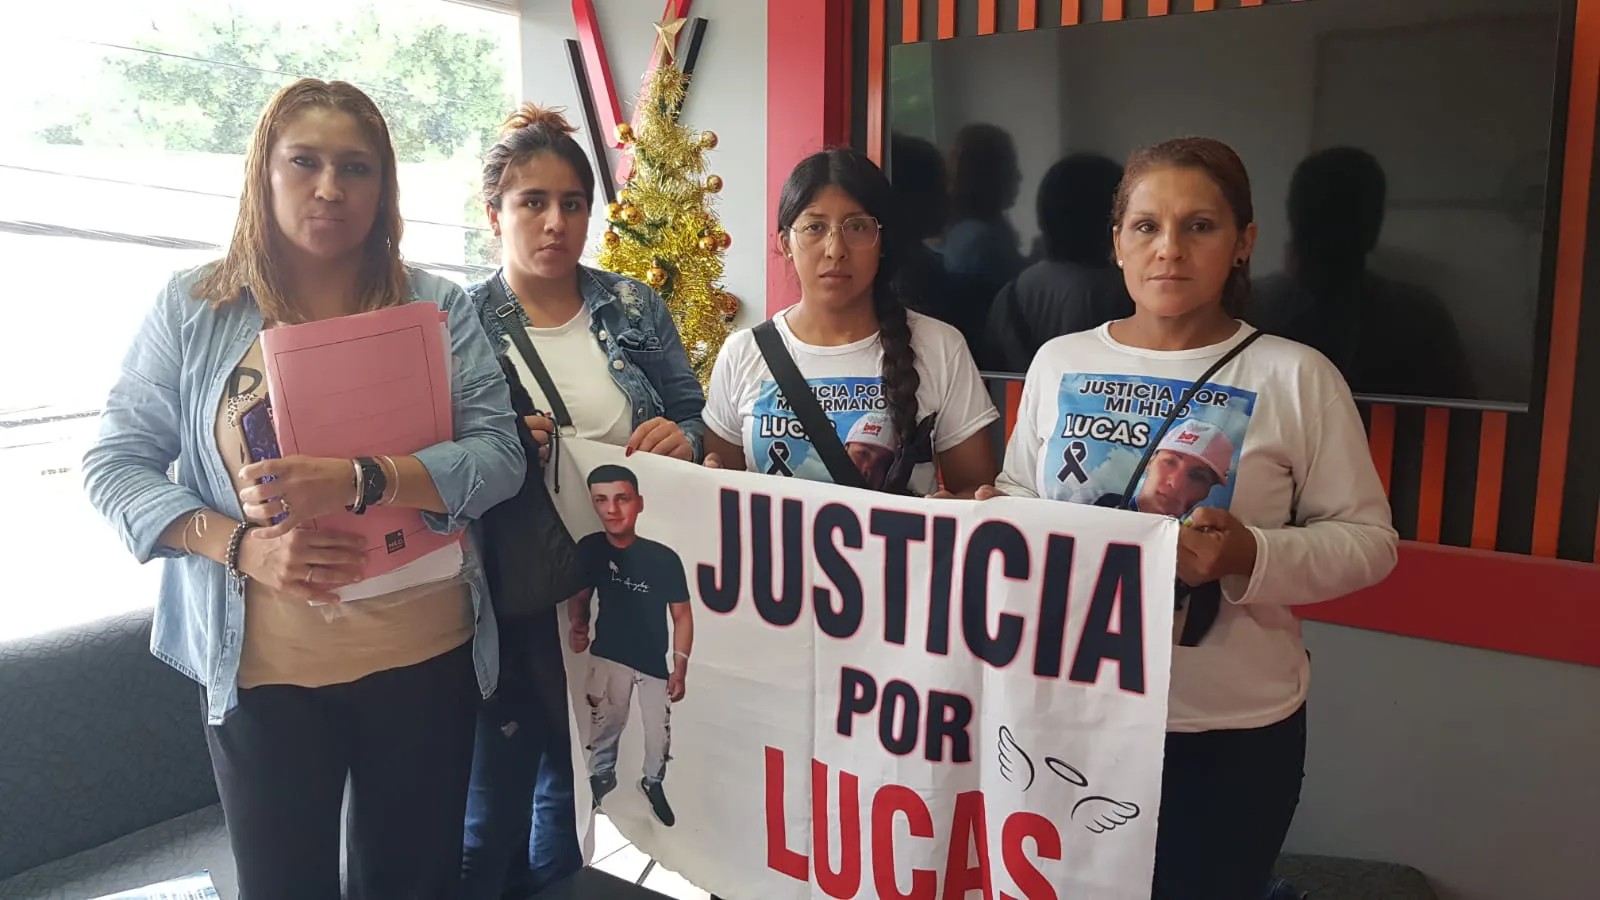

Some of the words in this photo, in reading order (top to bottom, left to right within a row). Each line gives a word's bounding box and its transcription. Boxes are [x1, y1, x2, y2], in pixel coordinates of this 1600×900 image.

[776, 399, 793, 411] M
[817, 397, 888, 411] RMANO
[1079, 380, 1173, 402] JUSTICIA
[1105, 397, 1132, 413] MI
[760, 414, 837, 441] LUC
[1061, 413, 1150, 448] LUCAS
[696, 486, 1147, 695] JUSTICIA
[836, 666, 973, 763] POR
[764, 745, 1062, 900] LUCAS
